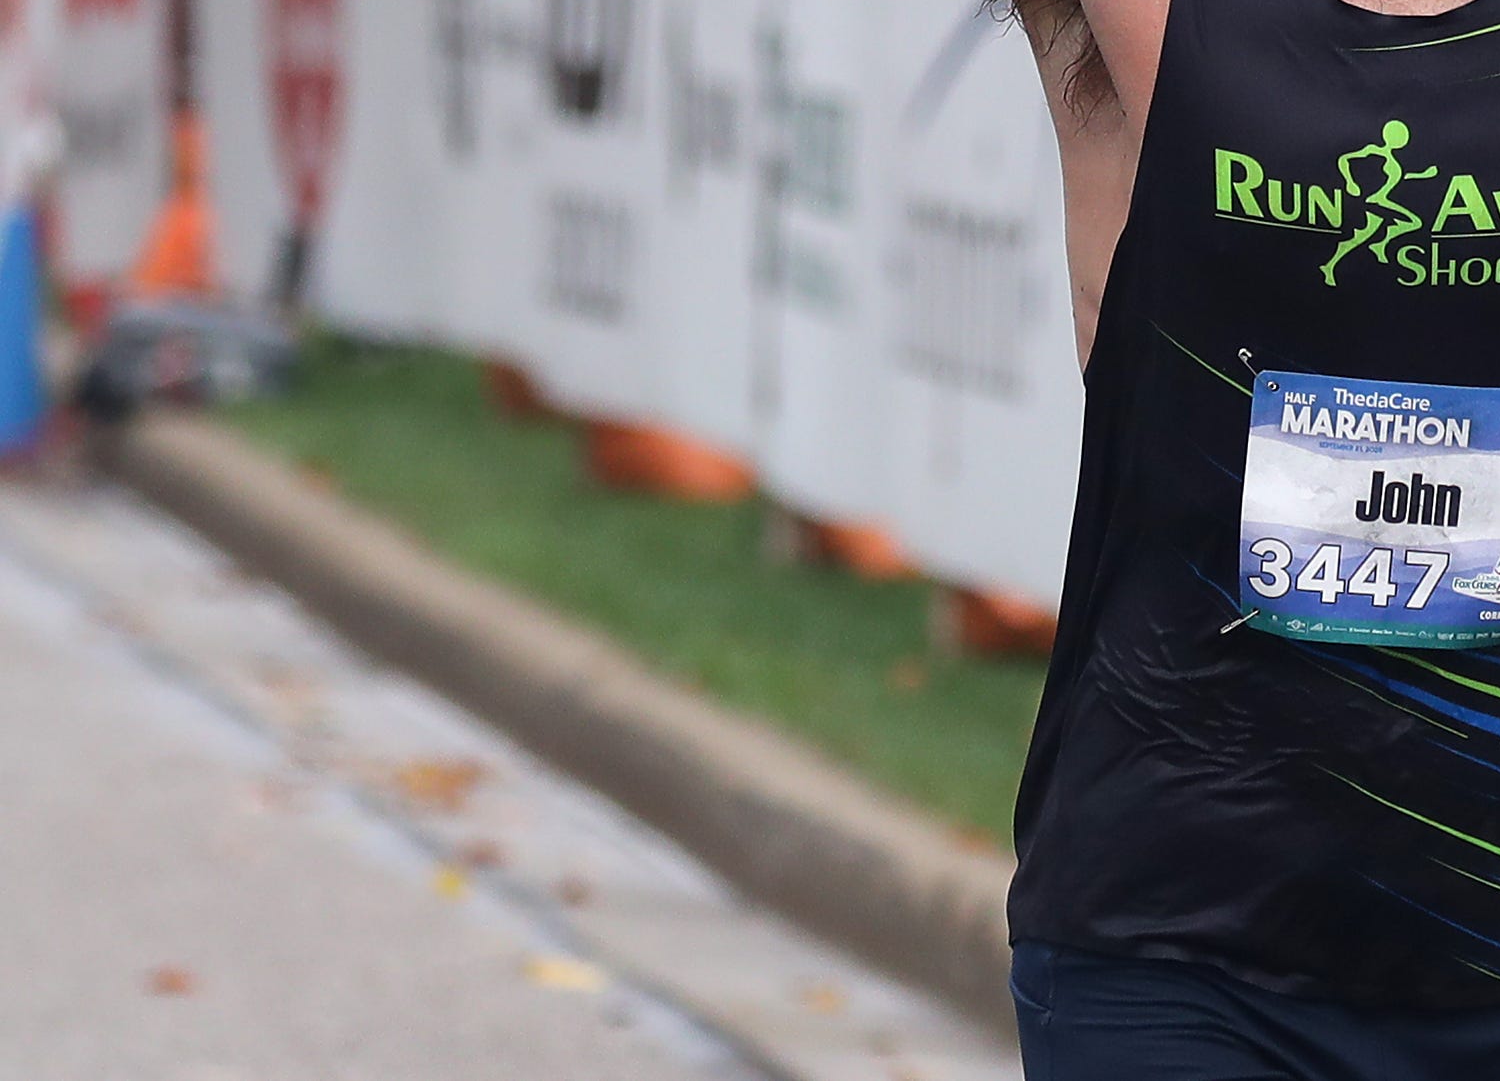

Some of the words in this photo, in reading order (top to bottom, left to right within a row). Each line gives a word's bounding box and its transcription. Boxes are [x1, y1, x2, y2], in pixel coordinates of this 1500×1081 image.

[1214, 147, 1343, 229] RUN
[1284, 391, 1317, 406] HALF
[1333, 387, 1431, 411] ThedaCare
[1281, 404, 1471, 448] MARATHON
[1355, 470, 1462, 528] John
[1249, 537, 1451, 610] 3447
